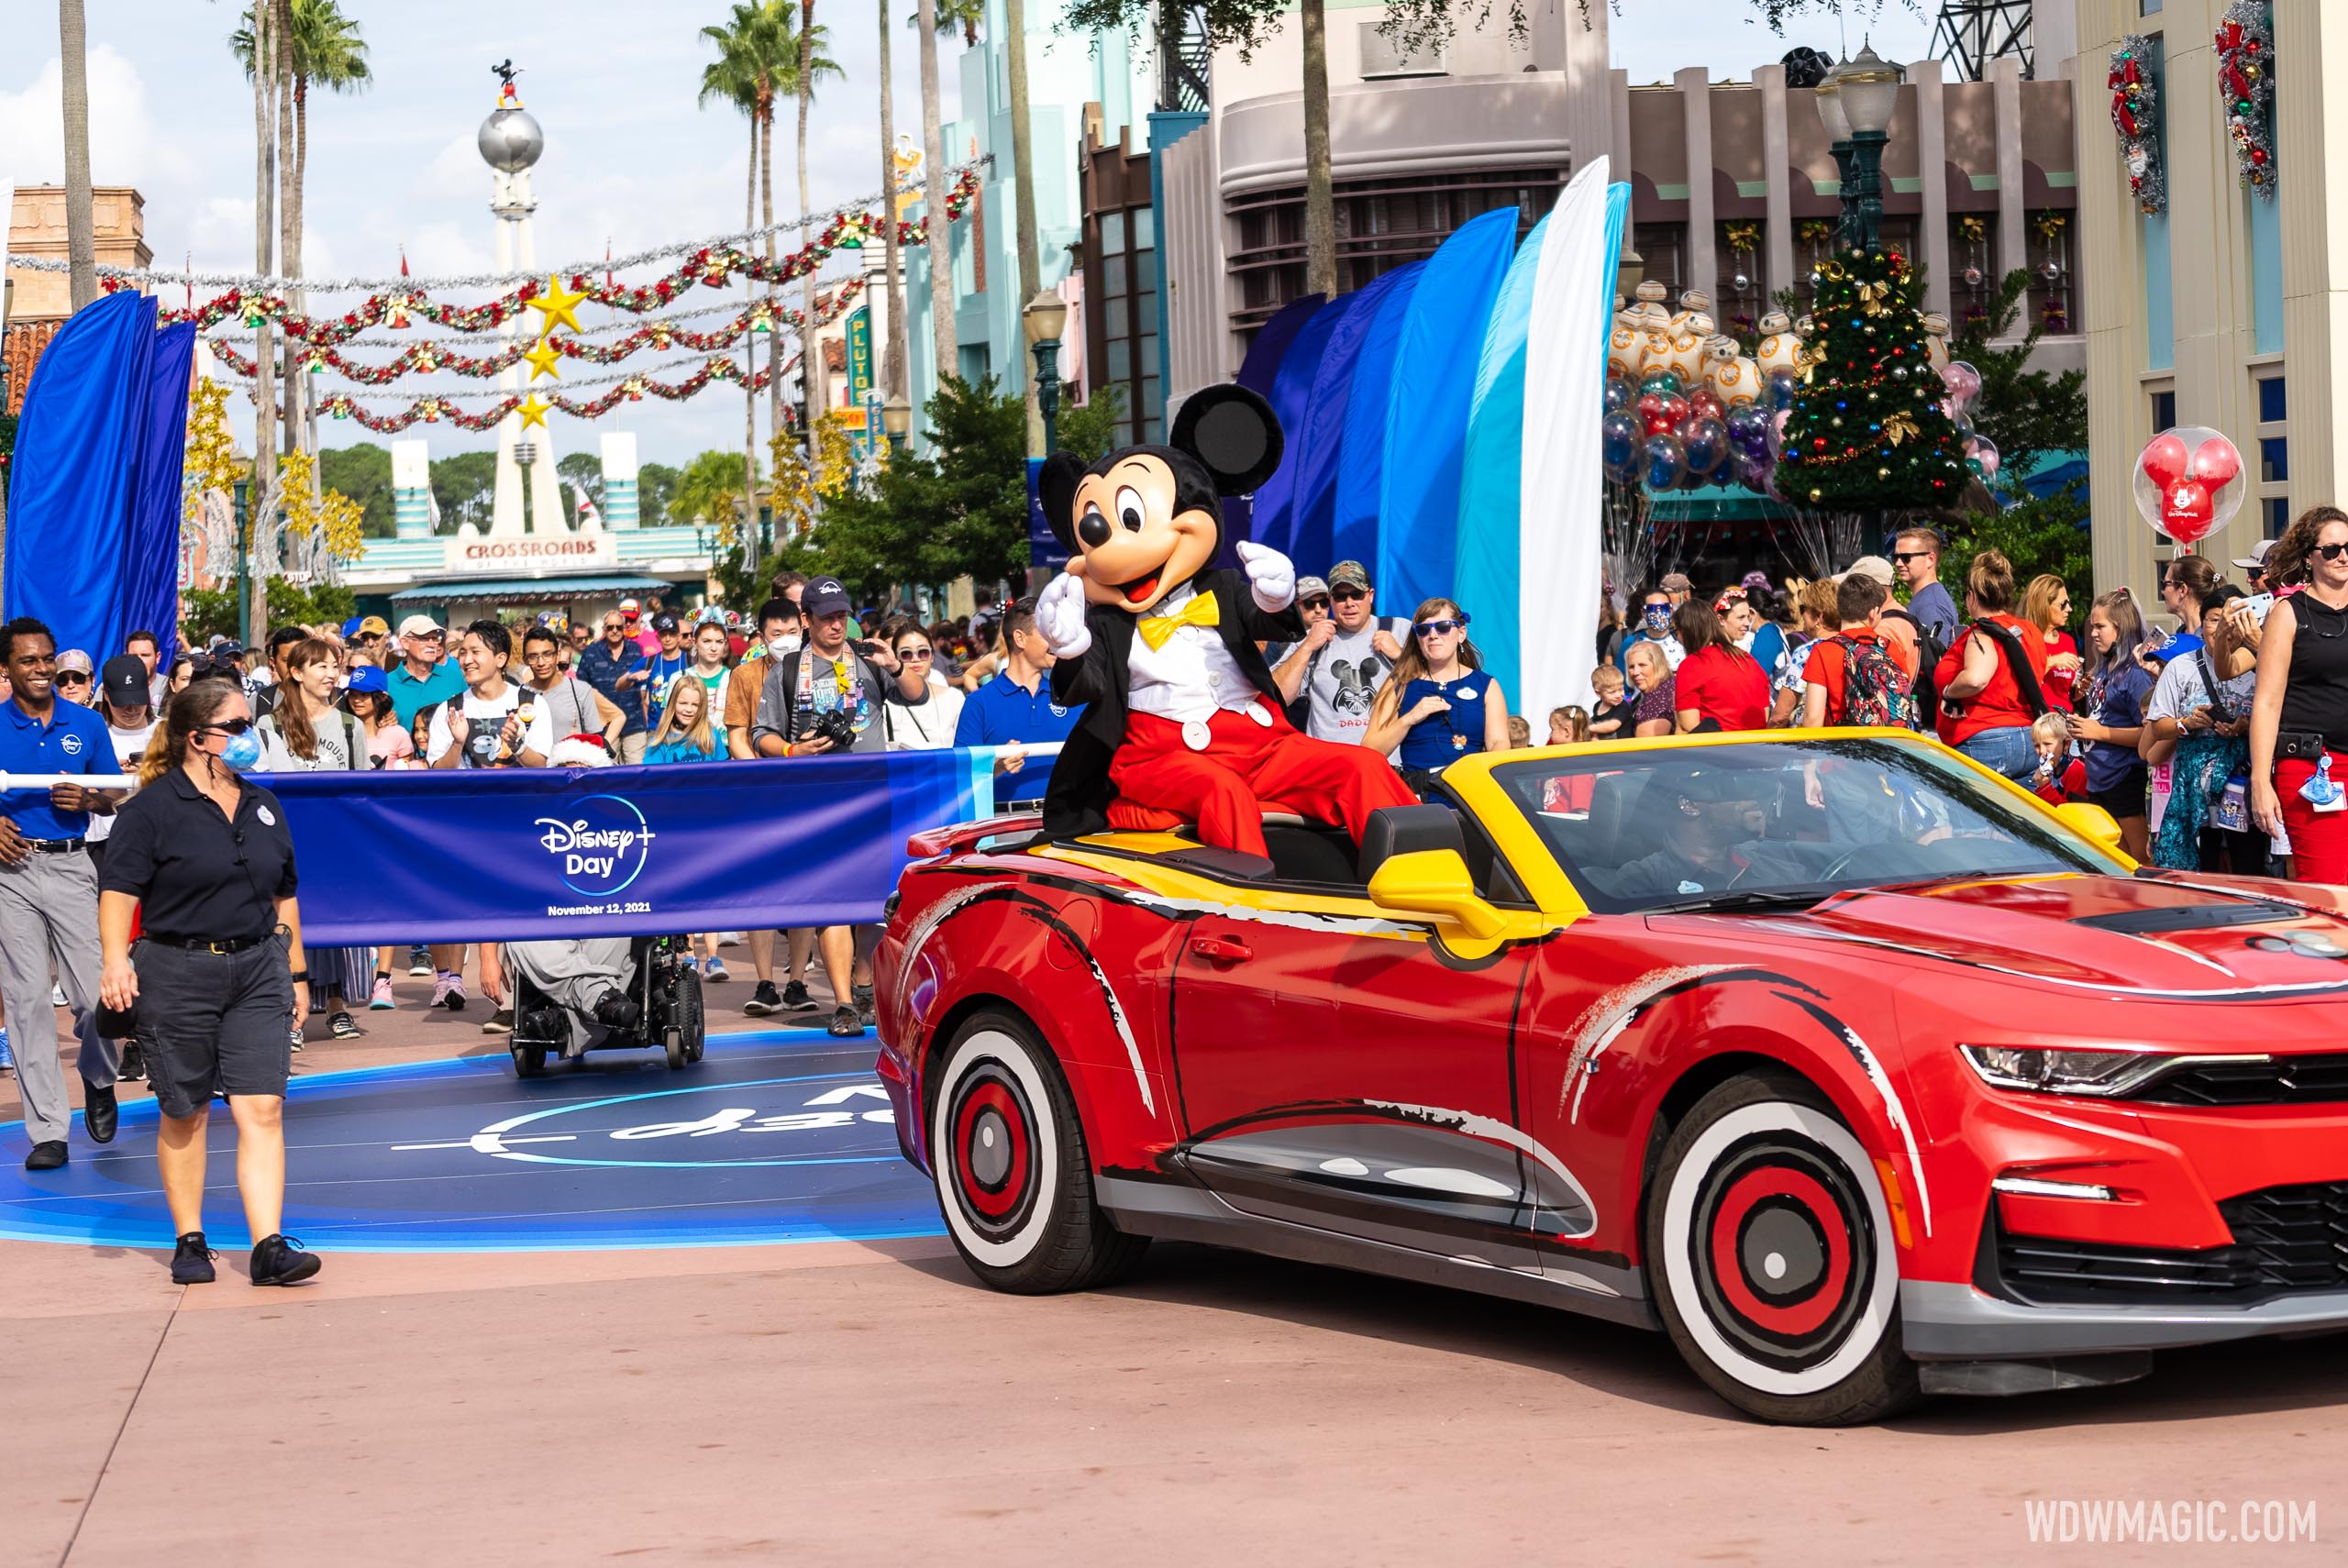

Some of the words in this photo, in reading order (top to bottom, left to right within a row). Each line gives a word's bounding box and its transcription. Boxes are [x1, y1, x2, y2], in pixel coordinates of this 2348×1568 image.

[466, 540, 597, 559] CROSSROADS
[317, 737, 347, 769] MOUSE
[566, 854, 615, 878] Day
[548, 904, 604, 916] November
[606, 903, 623, 915] 12,
[625, 901, 651, 913] 2021
